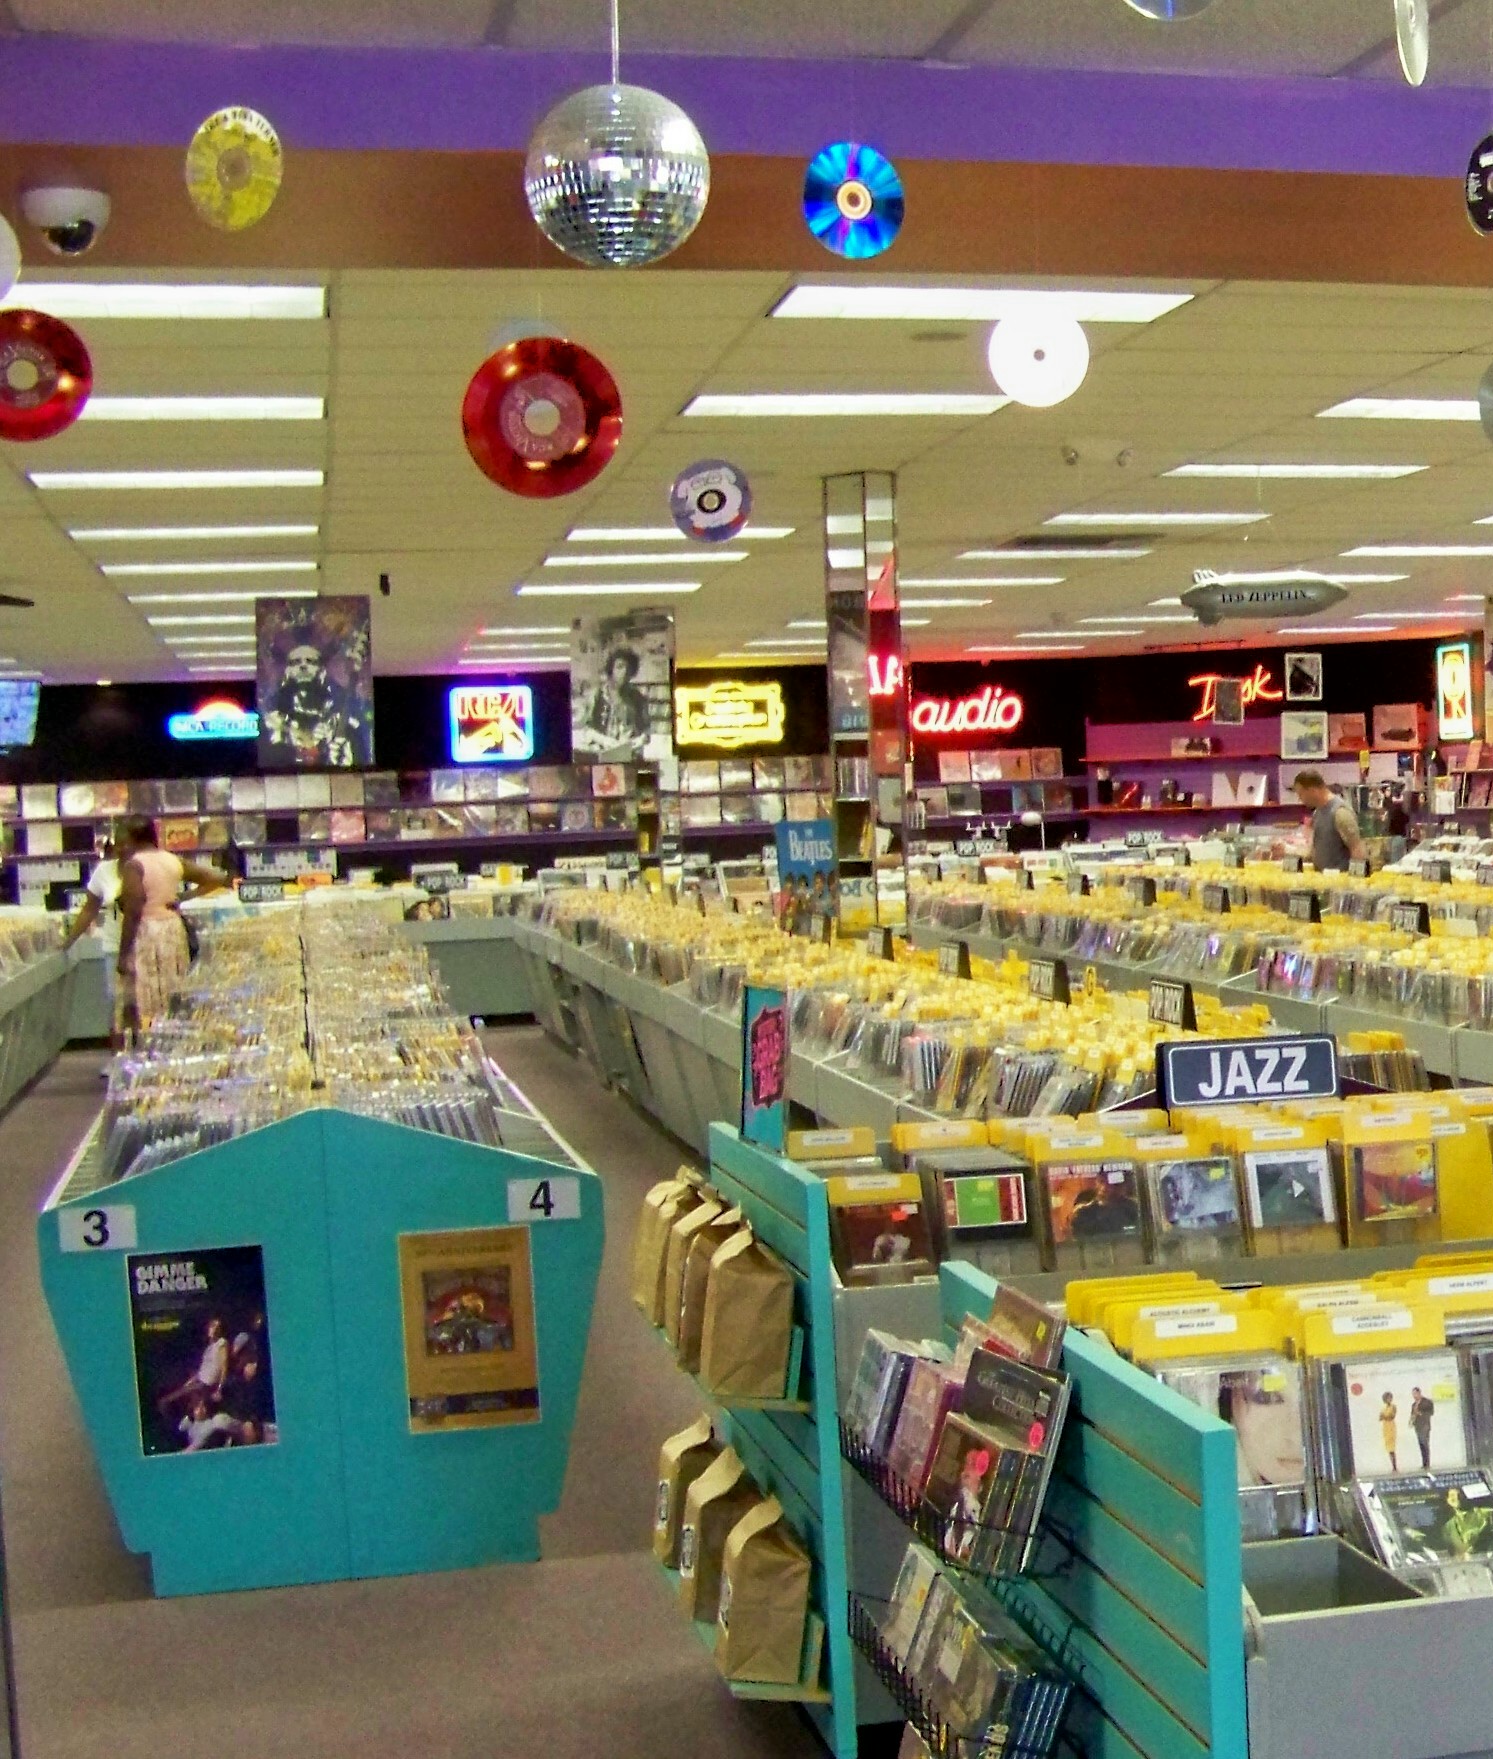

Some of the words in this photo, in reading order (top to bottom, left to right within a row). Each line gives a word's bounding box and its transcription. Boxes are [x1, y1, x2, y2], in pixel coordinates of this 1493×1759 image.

[206, 719, 258, 731] RECORD
[911, 687, 1022, 732] audio
[1197, 1045, 1309, 1098] JAZZ
[529, 1181, 554, 1217] 4
[83, 1210, 109, 1247] 3
[136, 1261, 195, 1280] GIMME
[137, 1273, 208, 1295] DANGER
